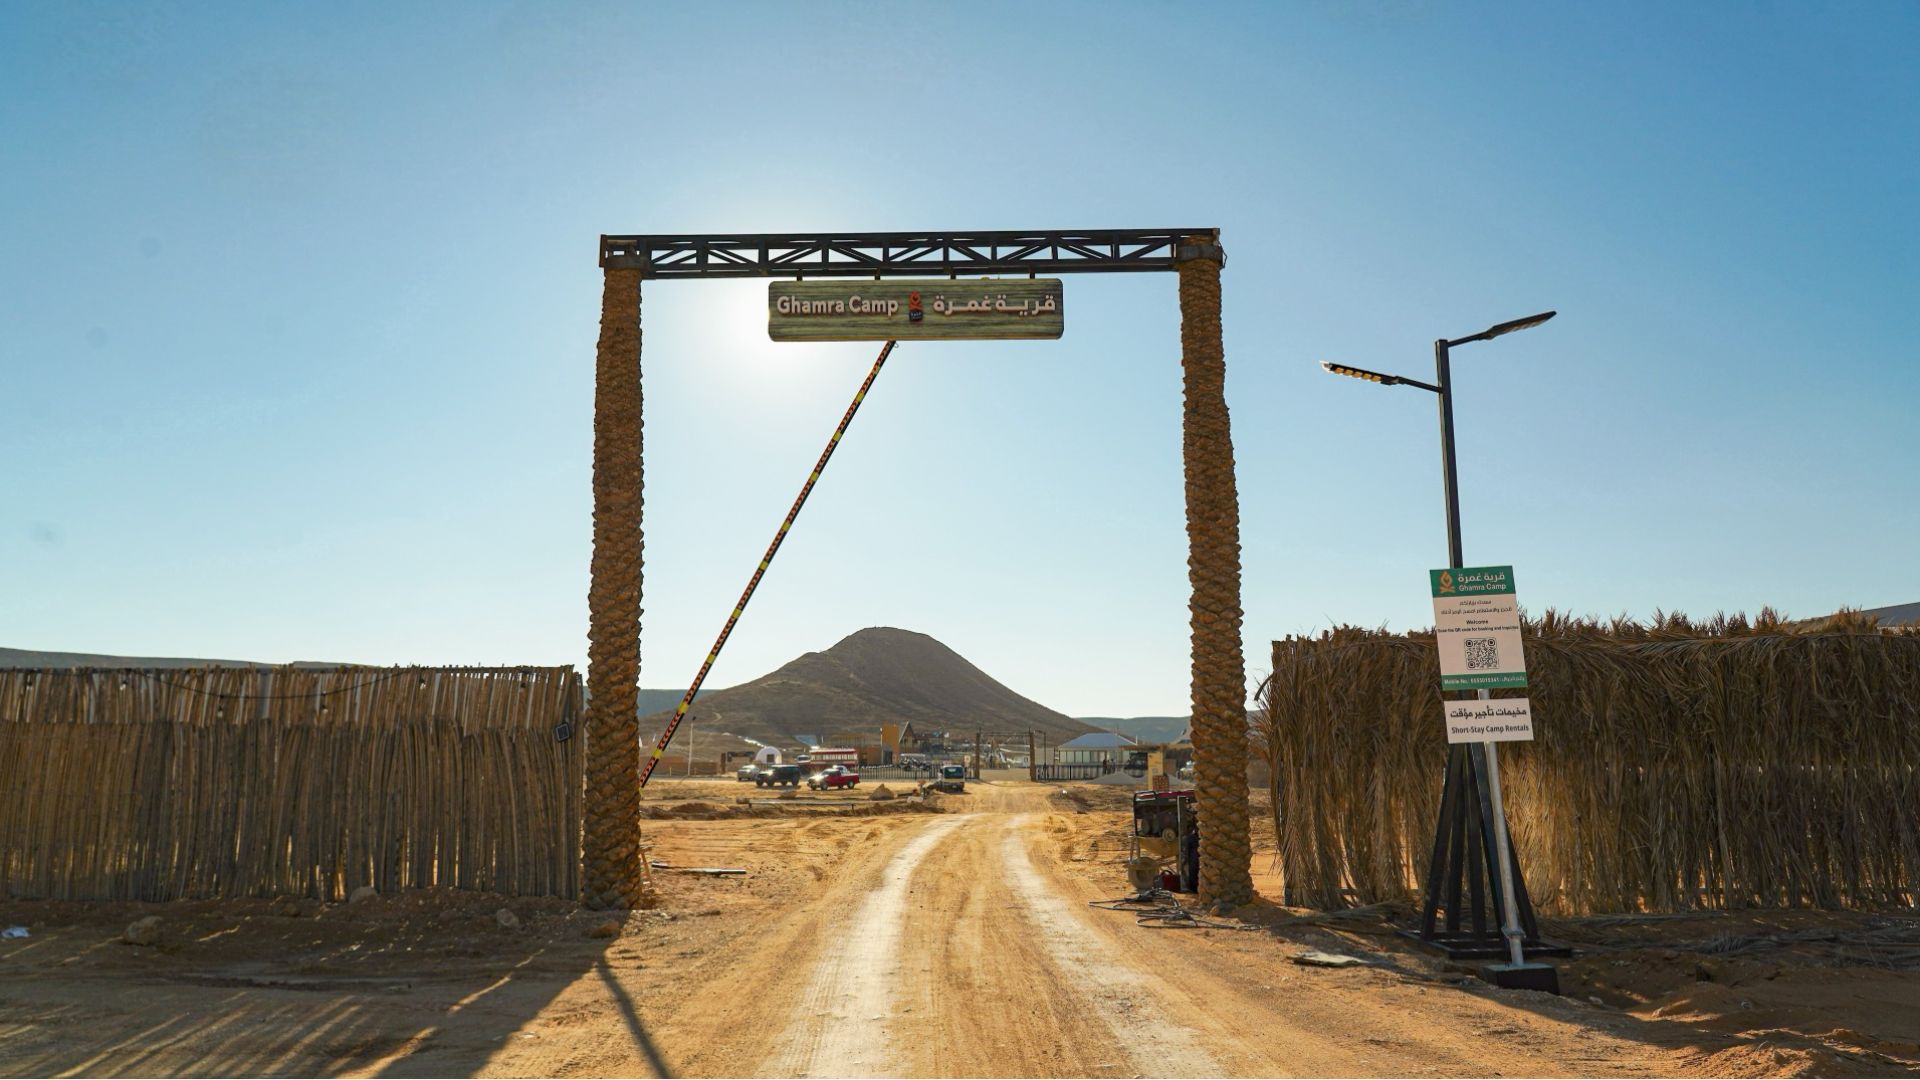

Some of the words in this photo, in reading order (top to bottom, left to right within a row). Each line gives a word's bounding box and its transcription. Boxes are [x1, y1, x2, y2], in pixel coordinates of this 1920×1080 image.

[777, 295, 845, 314] Ghamra
[848, 295, 898, 317] Camp
[933, 295, 992, 316] غمرة
[995, 294, 1056, 317] قرية
[1458, 573, 1482, 583] غمرة
[1484, 571, 1505, 583] قرية
[1458, 584, 1485, 592] Ghamra
[1486, 583, 1506, 591] Camp
[1450, 708, 1473, 720] مؤقت
[1474, 705, 1494, 719] تأجير
[1495, 707, 1527, 718] مخيمات
[1451, 725, 1485, 735] Short-Stay
[1485, 725, 1504, 733] Camp
[1505, 724, 1529, 732] Rentals
